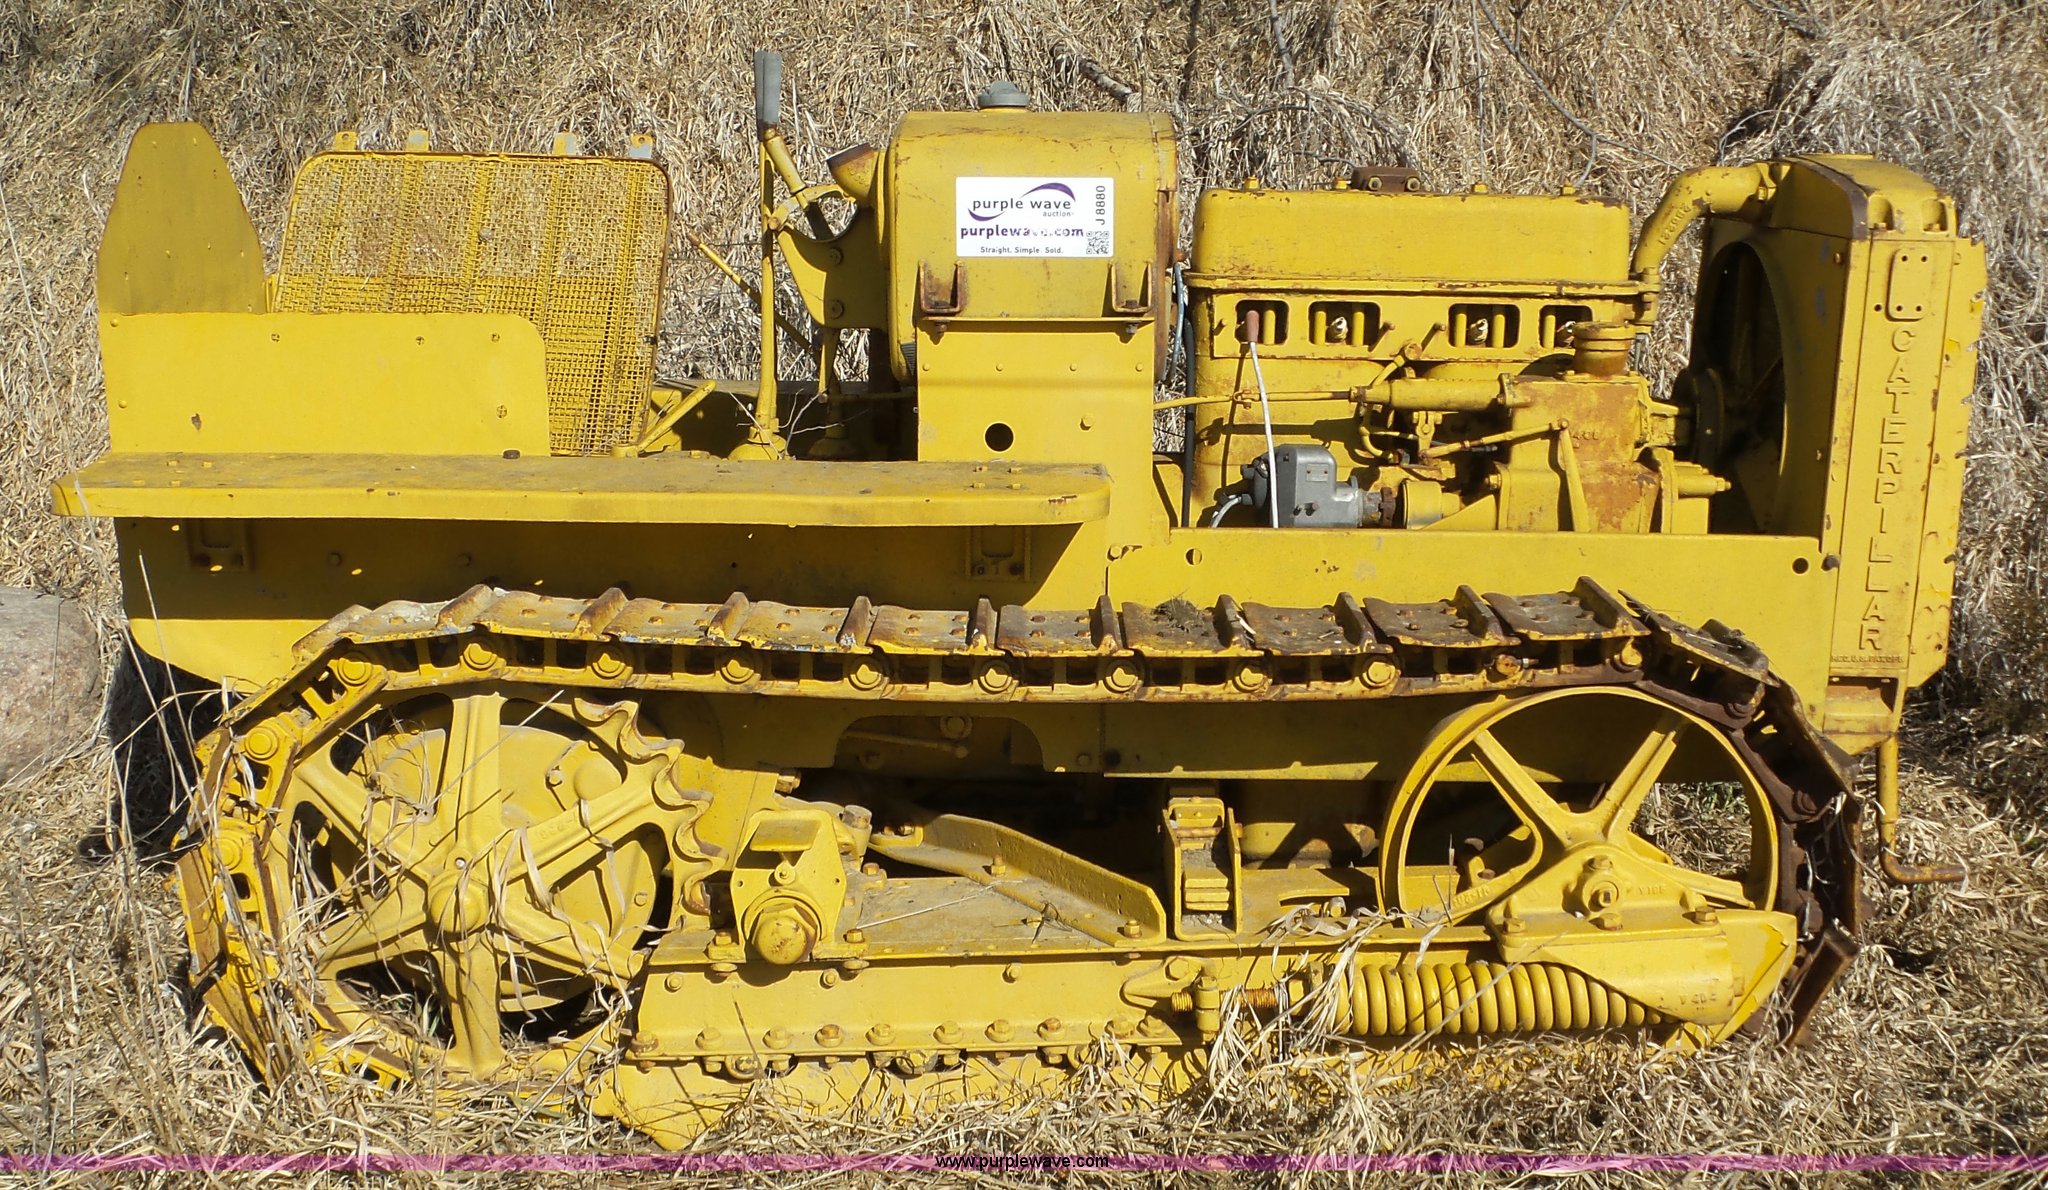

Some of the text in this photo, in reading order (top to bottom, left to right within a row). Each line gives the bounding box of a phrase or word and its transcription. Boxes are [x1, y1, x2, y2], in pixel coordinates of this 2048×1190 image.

[972, 198, 1072, 212] purple wave
[1858, 328, 1916, 651] CATERPILLAR
